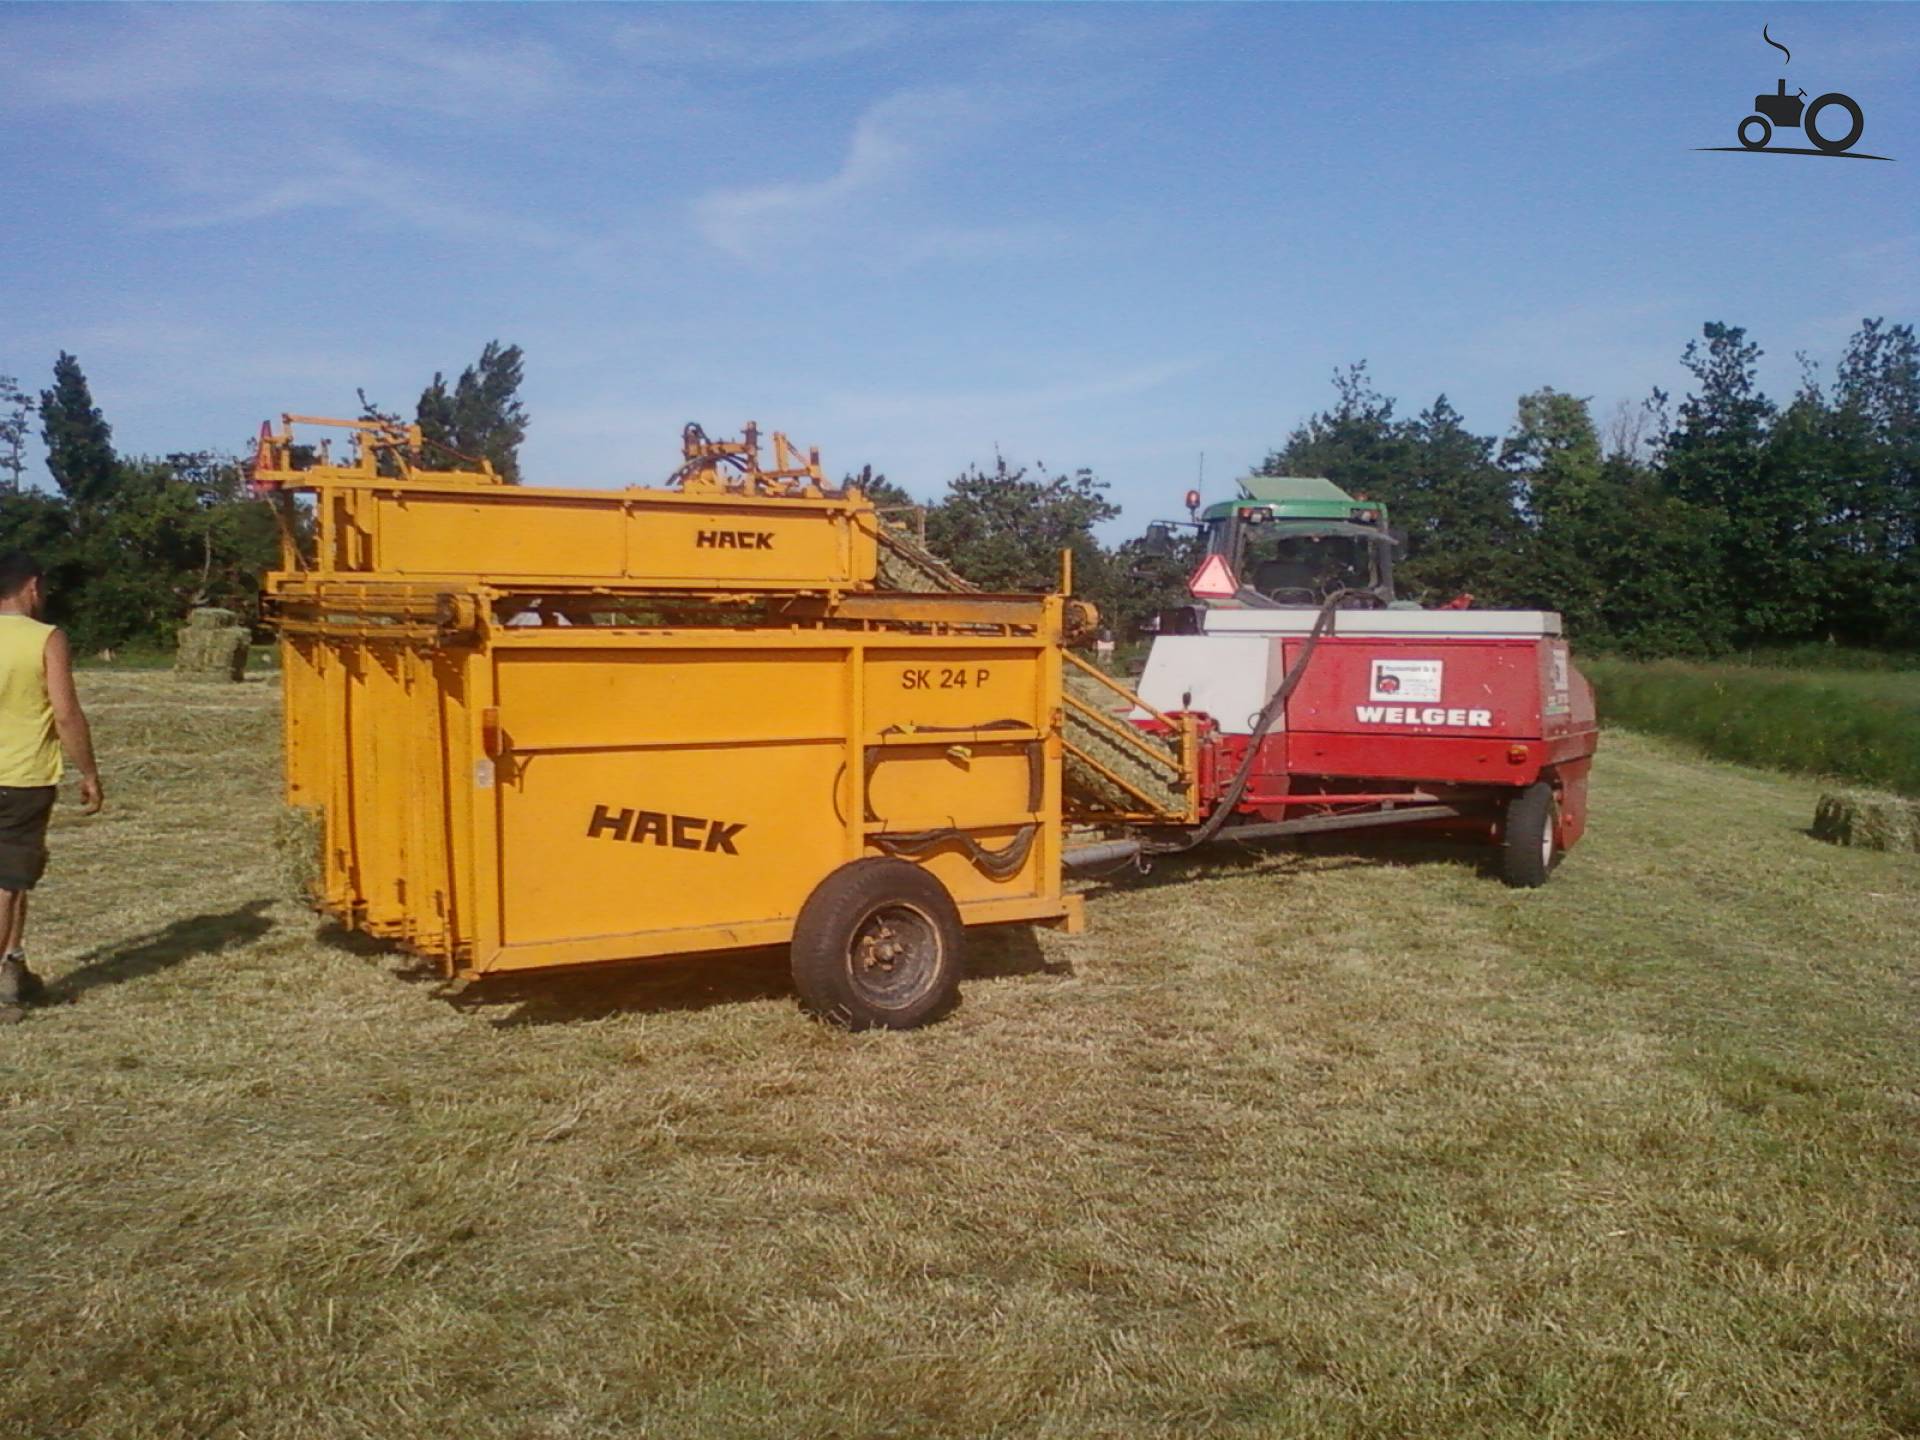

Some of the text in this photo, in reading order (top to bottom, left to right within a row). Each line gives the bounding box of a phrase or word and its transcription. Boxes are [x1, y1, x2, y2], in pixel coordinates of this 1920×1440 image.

[696, 530, 776, 550] HACK
[902, 668, 990, 690] SK 24 P
[1356, 706, 1492, 727] WELGER
[586, 804, 748, 856] HACK
